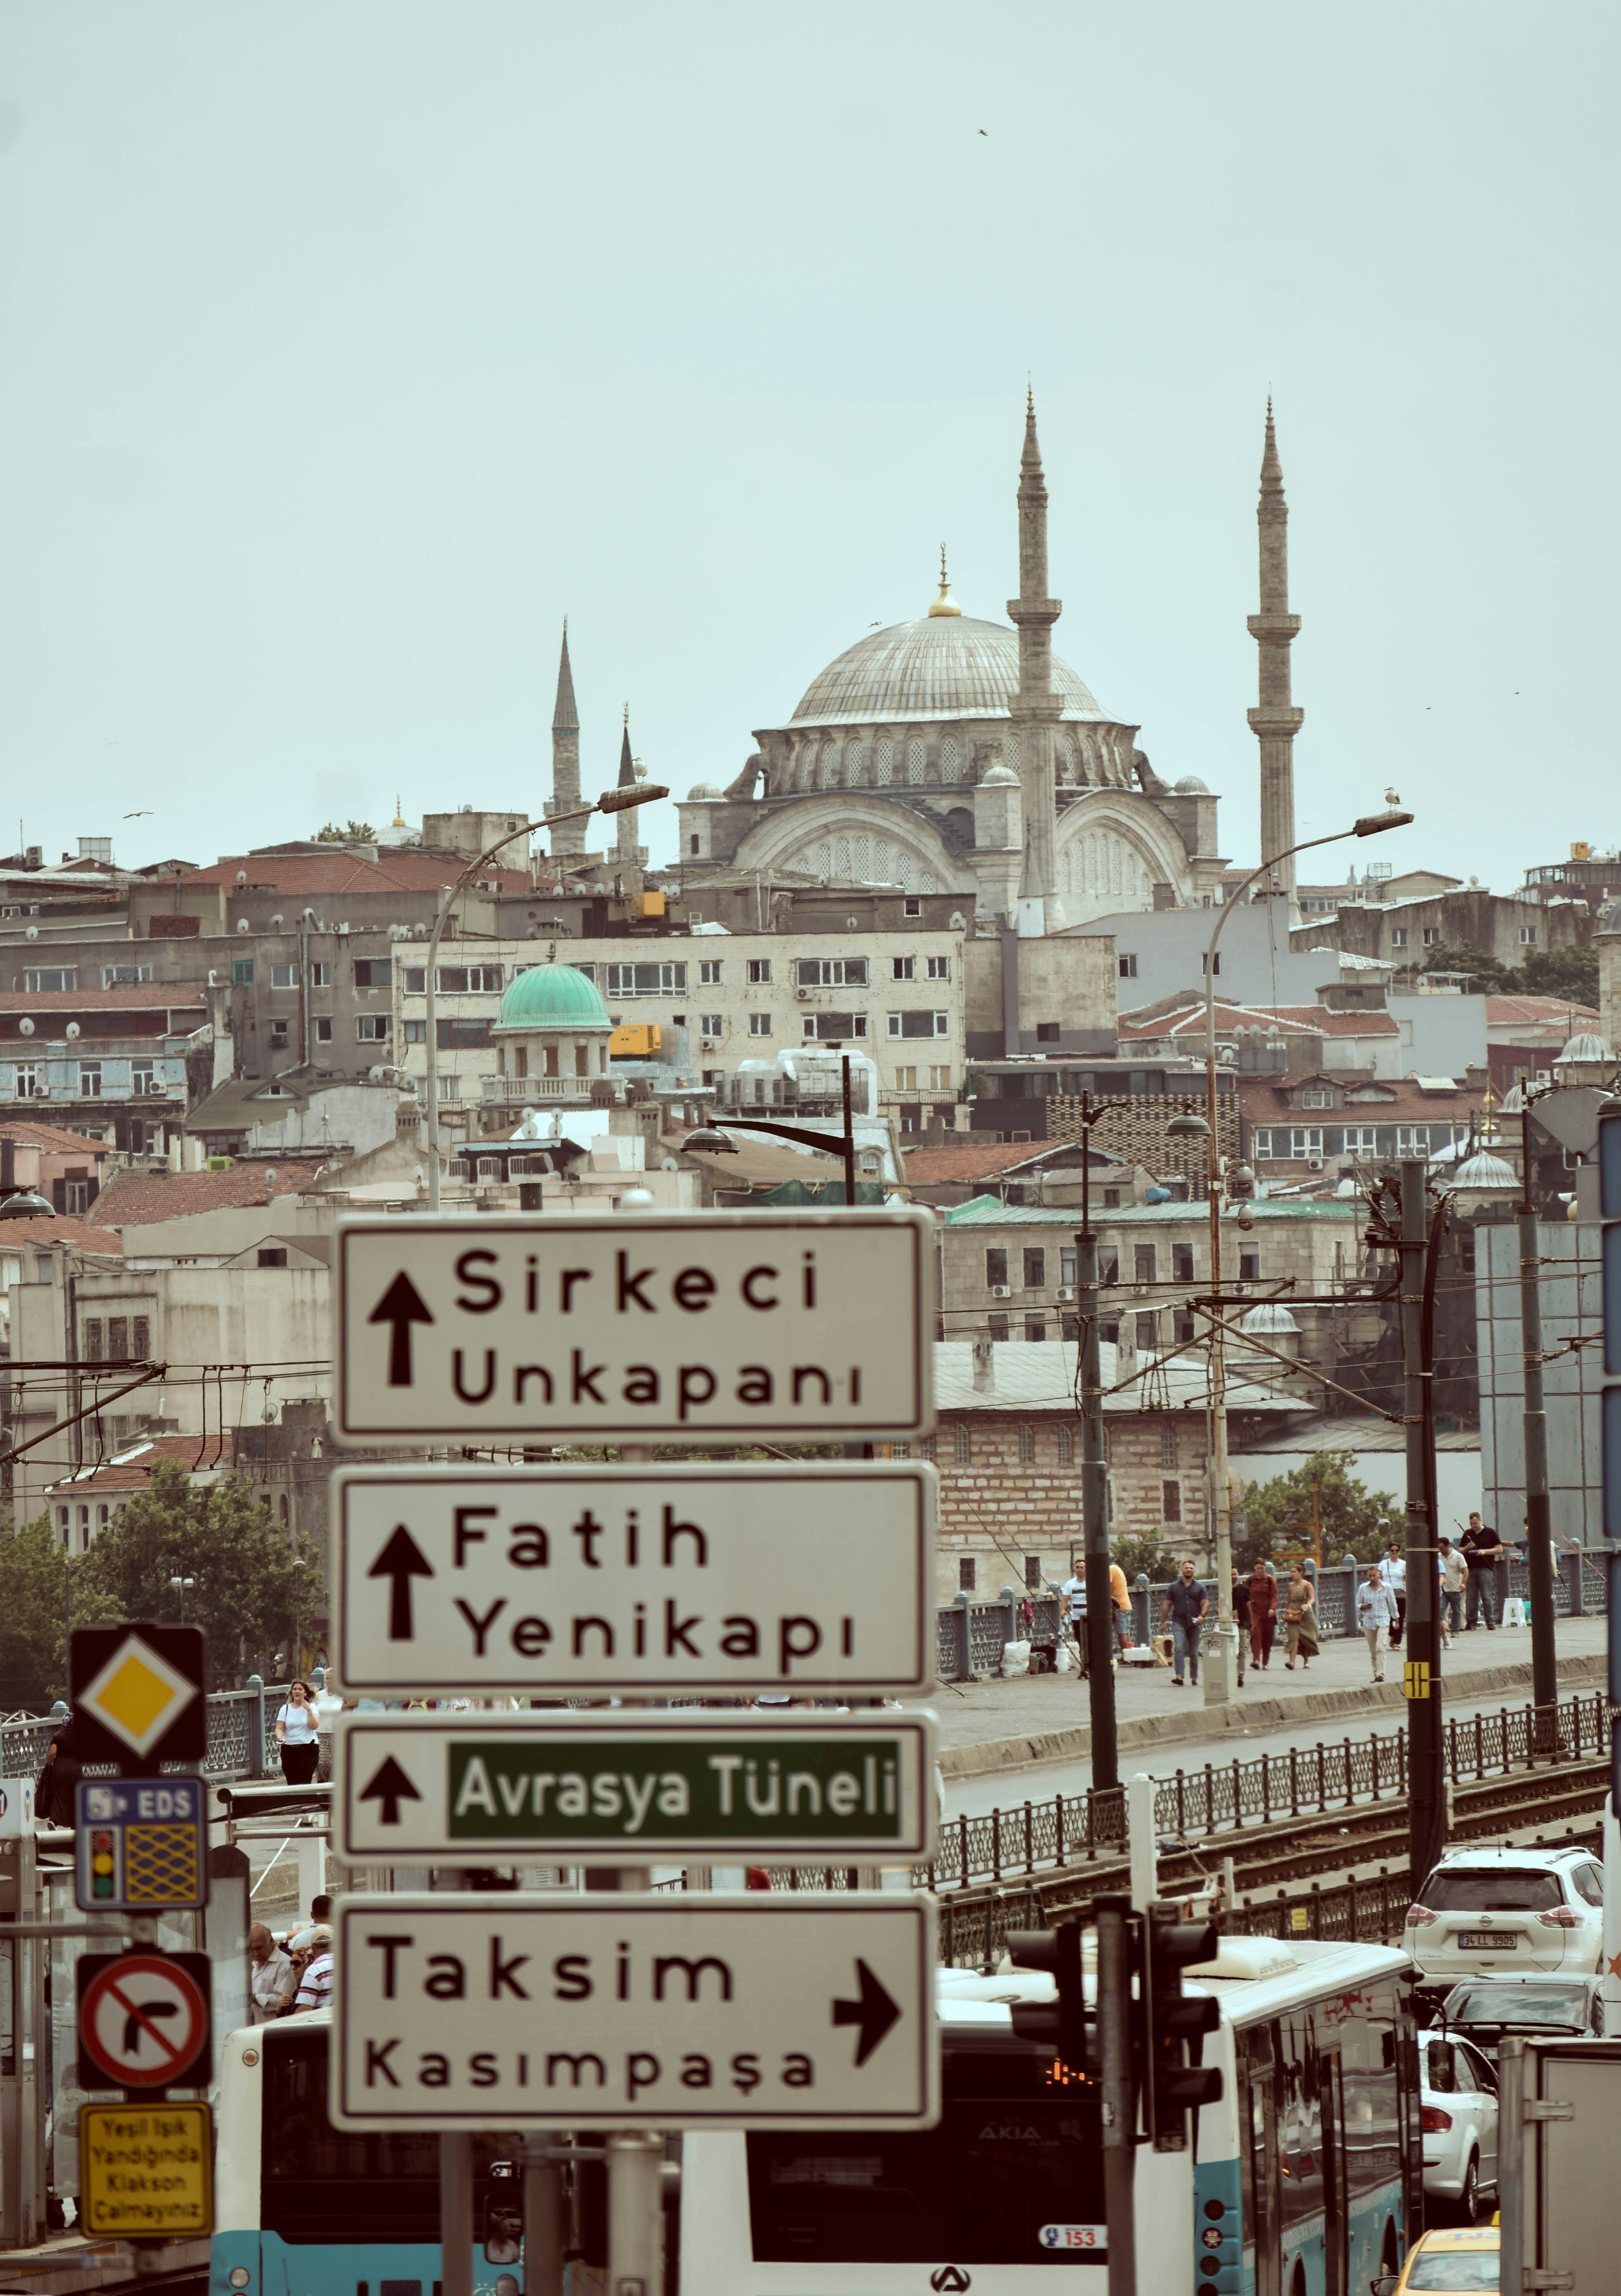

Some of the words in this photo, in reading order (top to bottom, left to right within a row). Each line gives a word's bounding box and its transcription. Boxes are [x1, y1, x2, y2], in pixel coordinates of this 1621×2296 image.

[454, 1248, 816, 1315] Sirkeci
[451, 1347, 861, 1423] Unkapanı
[452, 1503, 709, 1570] Fatih
[453, 1597, 854, 1677] Yenikapı
[138, 1789, 193, 1819] EDS
[455, 1755, 690, 1833] Avrasya
[708, 1754, 897, 1816] Tüneli
[365, 1934, 734, 2003] Taksim
[1464, 1935, 1475, 1945] 34
[1478, 1935, 1489, 1945] LL
[1492, 1935, 1514, 1945] 9905
[364, 2037, 814, 2103] Kasımpaşa
[100, 2117, 148, 2138] Yeşil
[978, 2126, 1041, 2140] AKIA
[105, 2174, 187, 2193] Klakson
[1066, 2231, 1095, 2246] 153
